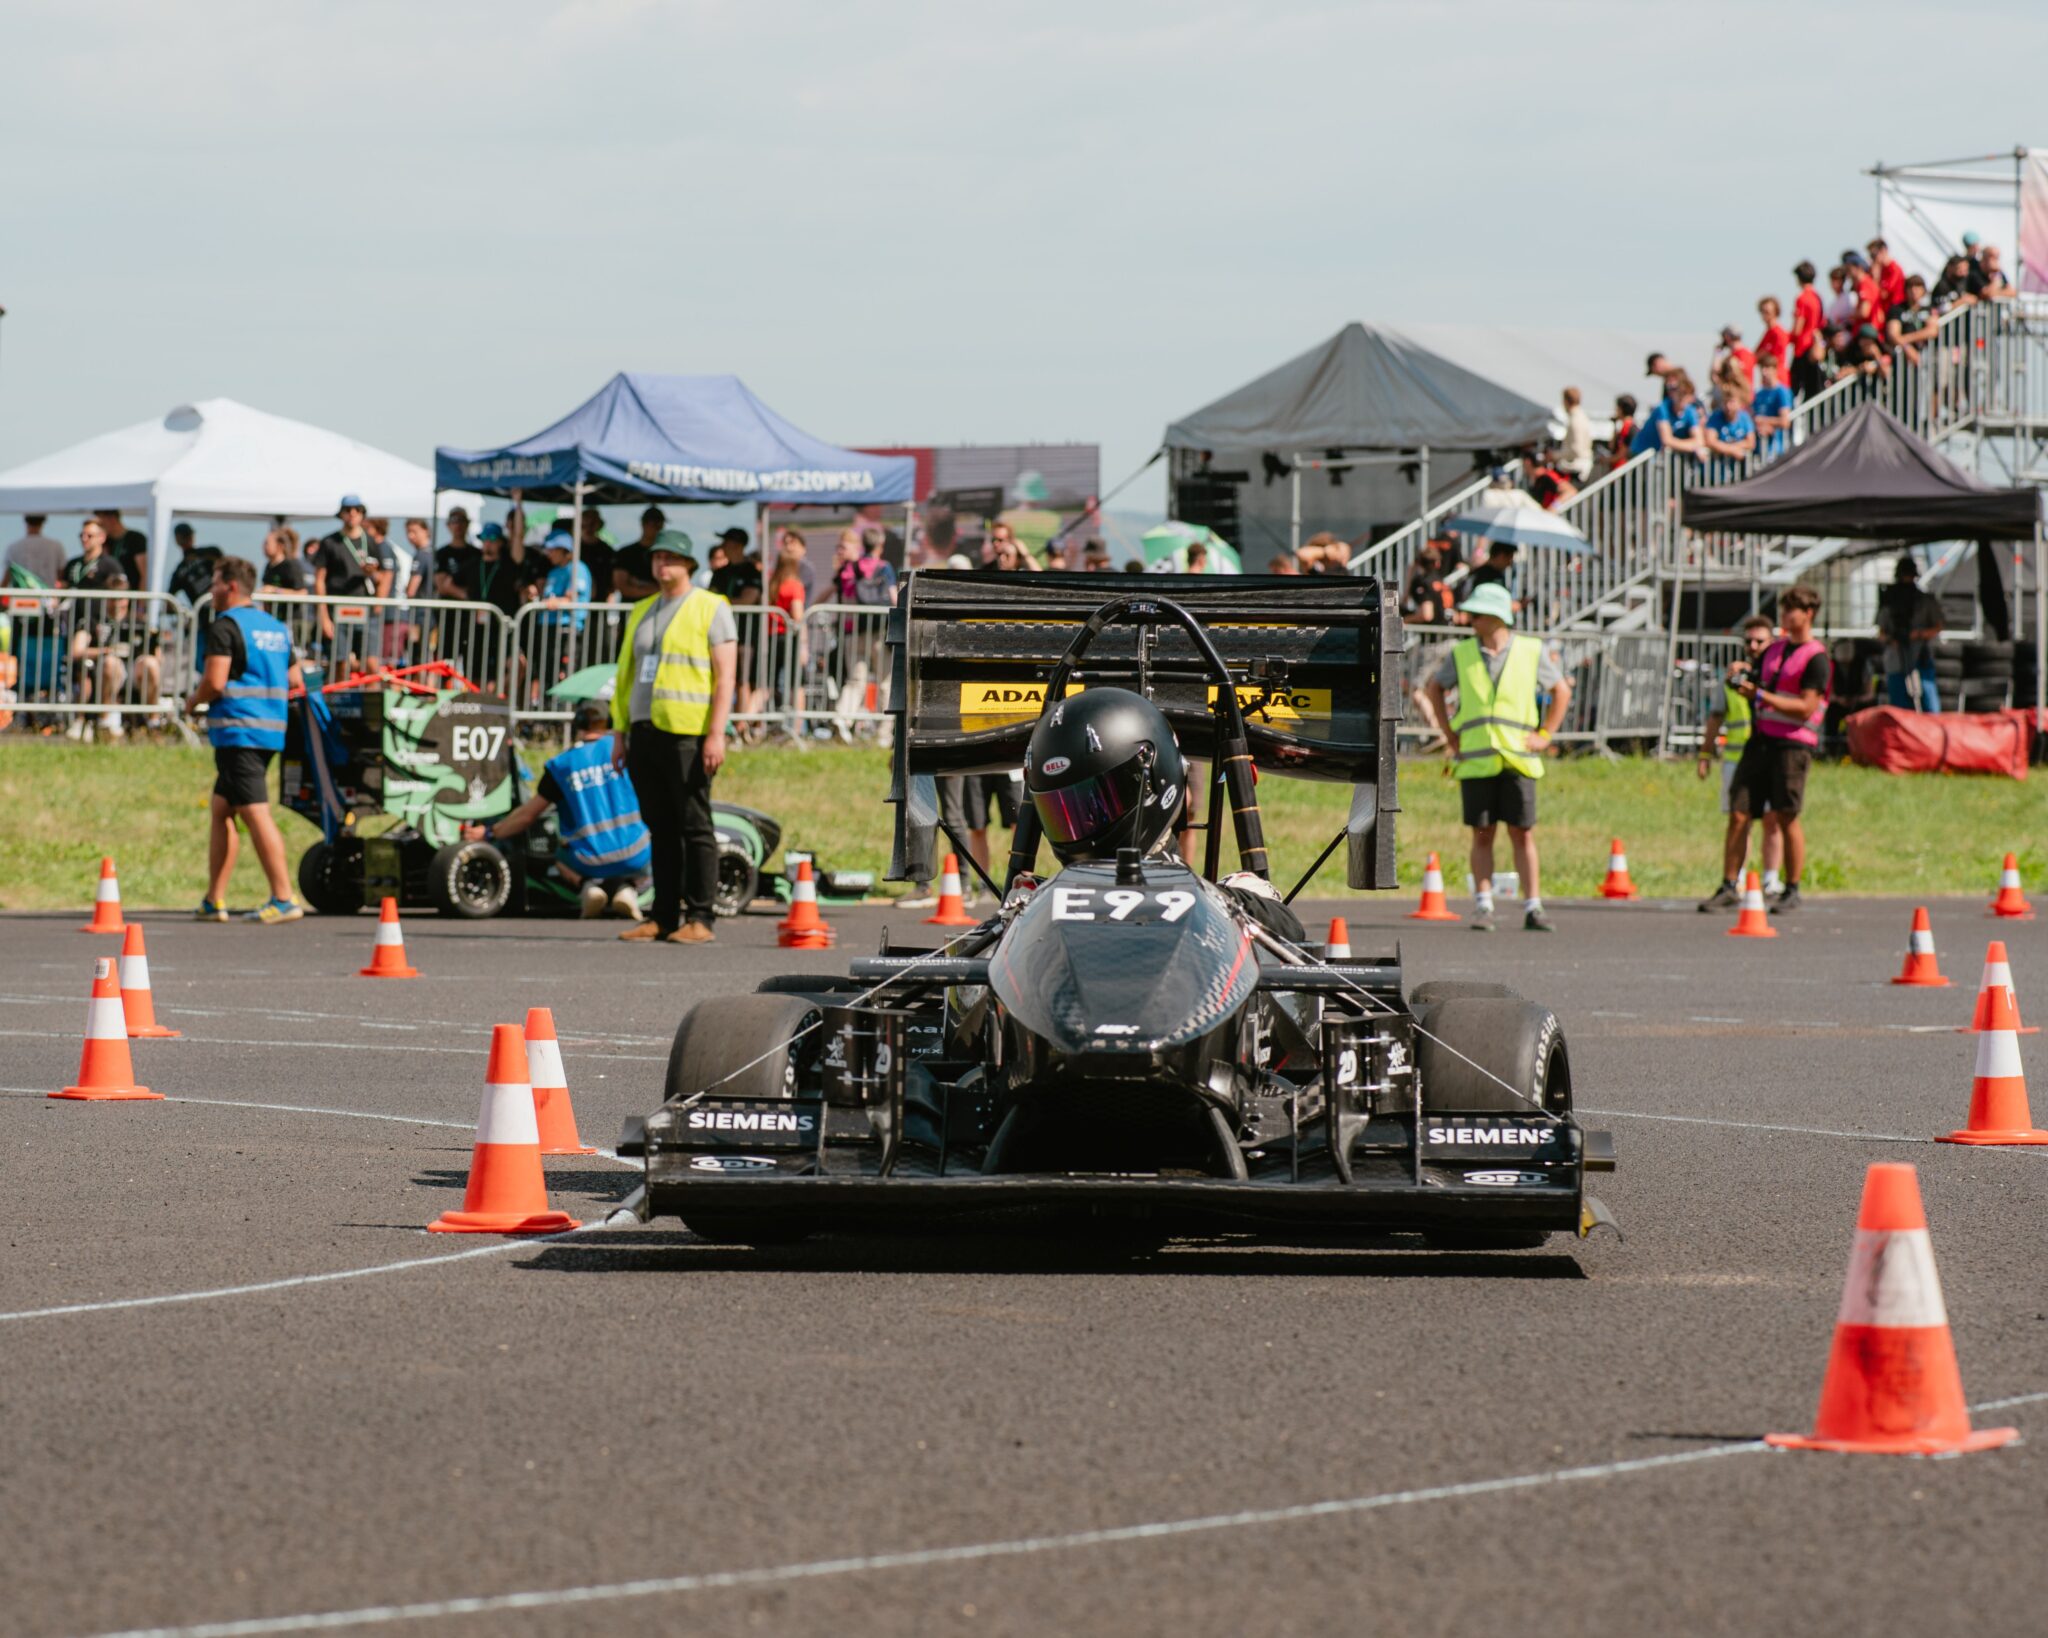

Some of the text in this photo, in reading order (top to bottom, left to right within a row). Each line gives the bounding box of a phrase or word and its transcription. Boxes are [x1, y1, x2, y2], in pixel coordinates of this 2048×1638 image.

[627, 460, 760, 492] POLITECHNIKA
[981, 690, 1047, 703] ADA
[453, 726, 506, 760] E07
[1046, 762, 1067, 772] BELL
[1052, 888, 1196, 922] E99
[689, 1112, 814, 1131] SIEMENS
[1429, 1128, 1556, 1144] SIEMENS
[698, 1160, 769, 1169] ODU
[1471, 1175, 1542, 1183] ODU
